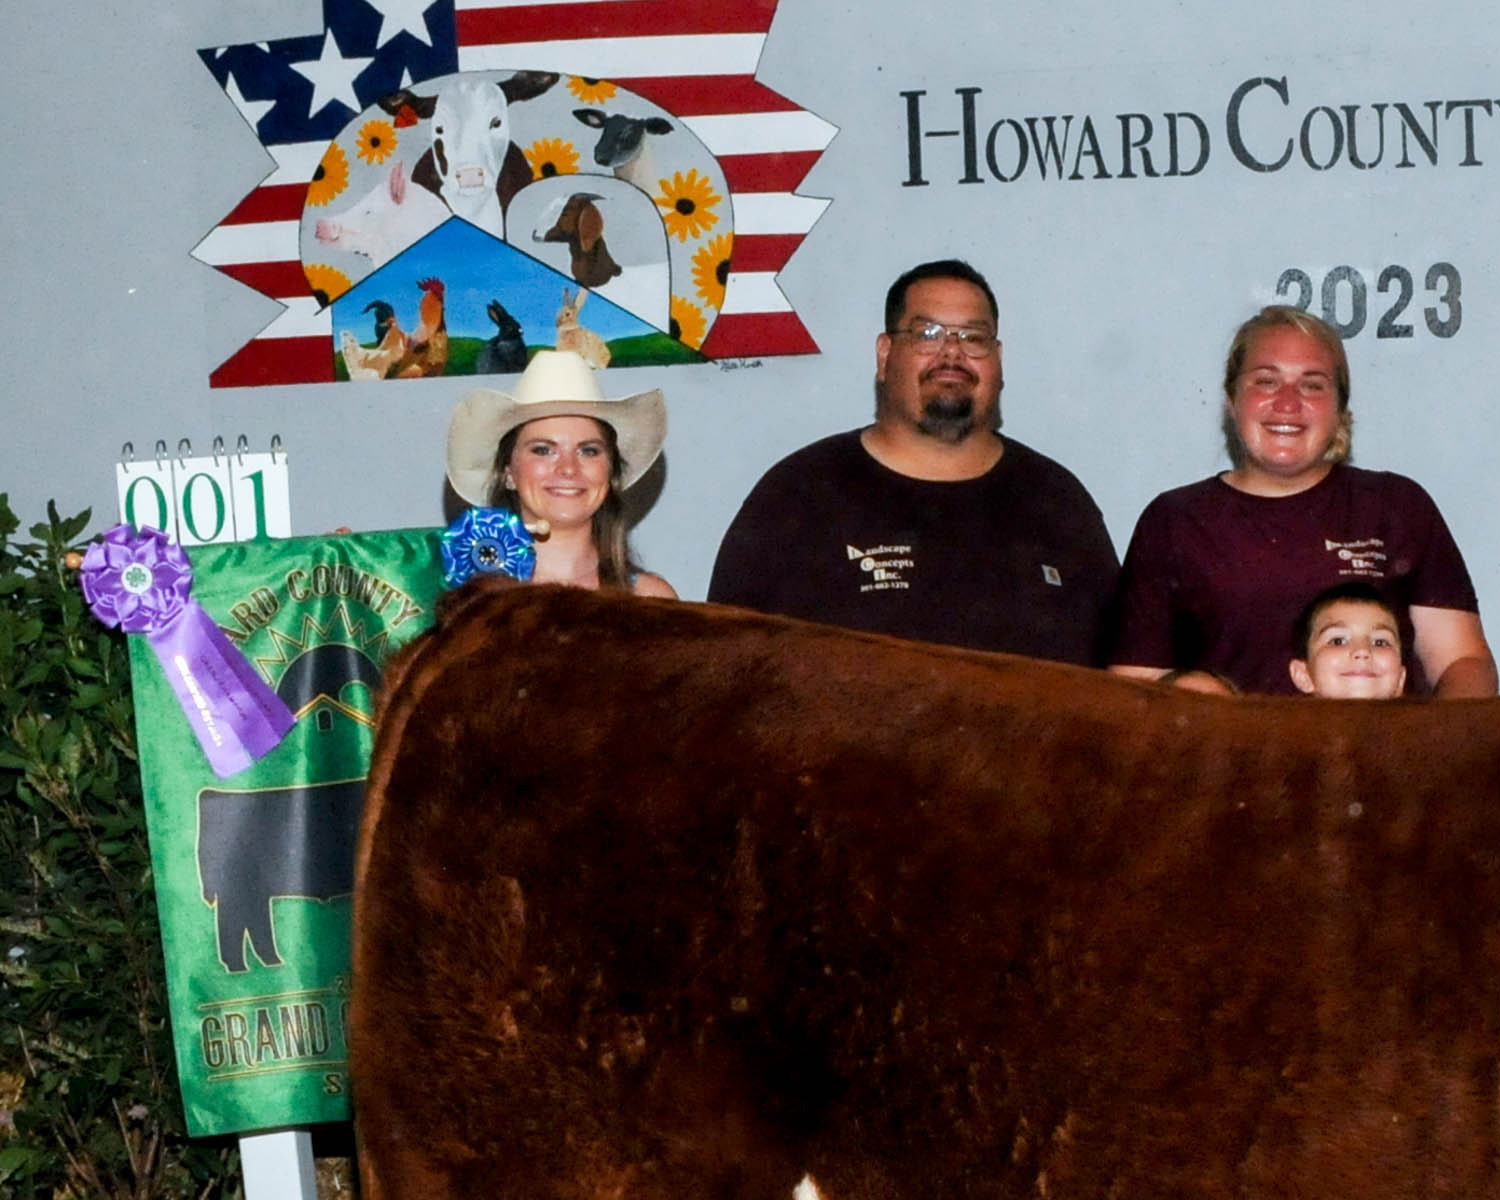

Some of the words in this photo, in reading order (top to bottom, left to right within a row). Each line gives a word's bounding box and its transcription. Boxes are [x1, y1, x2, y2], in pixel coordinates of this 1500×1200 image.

[899, 86, 1211, 188] HOWARD
[1276, 262, 1462, 339] 2023
[125, 470, 278, 543] 001
[285, 563, 425, 628] COUNTY
[201, 1002, 331, 1069] GRAND
